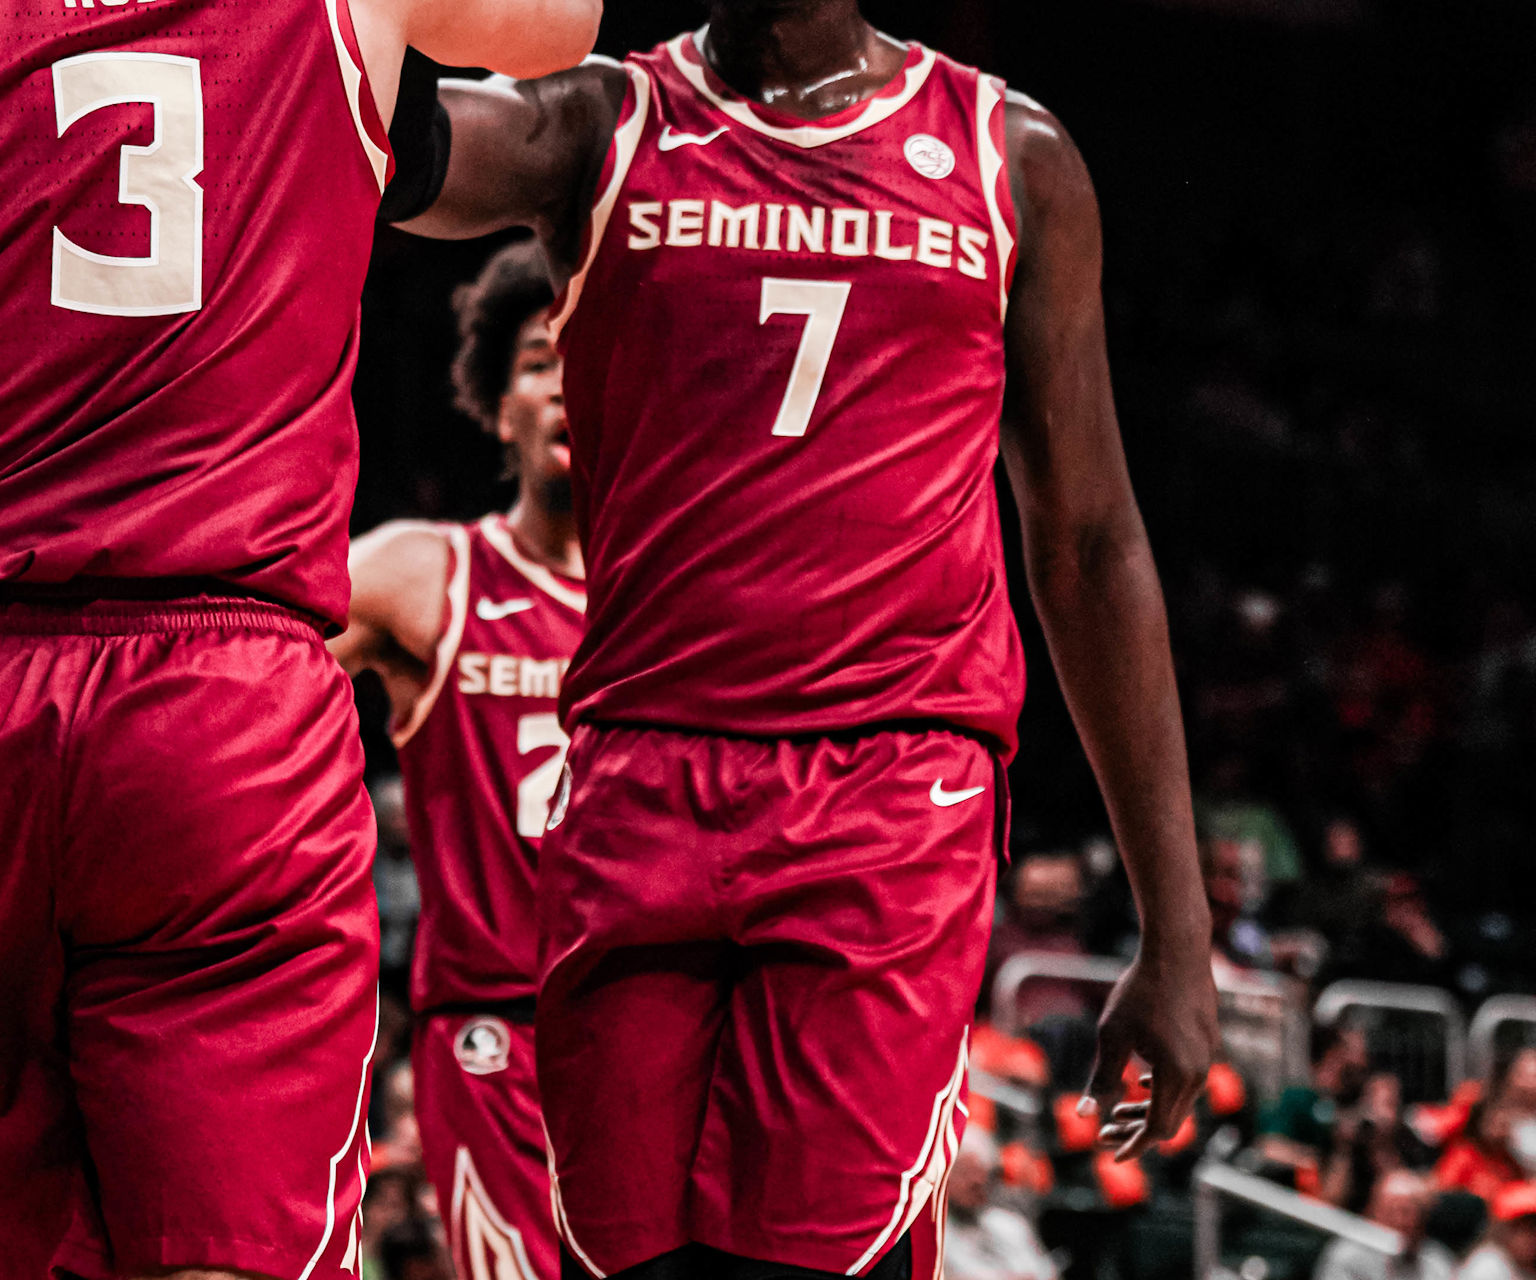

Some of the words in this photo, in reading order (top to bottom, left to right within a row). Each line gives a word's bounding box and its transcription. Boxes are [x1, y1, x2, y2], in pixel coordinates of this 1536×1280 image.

[51, 51, 204, 317] 3
[628, 199, 990, 280] SEMINOLES
[759, 276, 852, 437] 7
